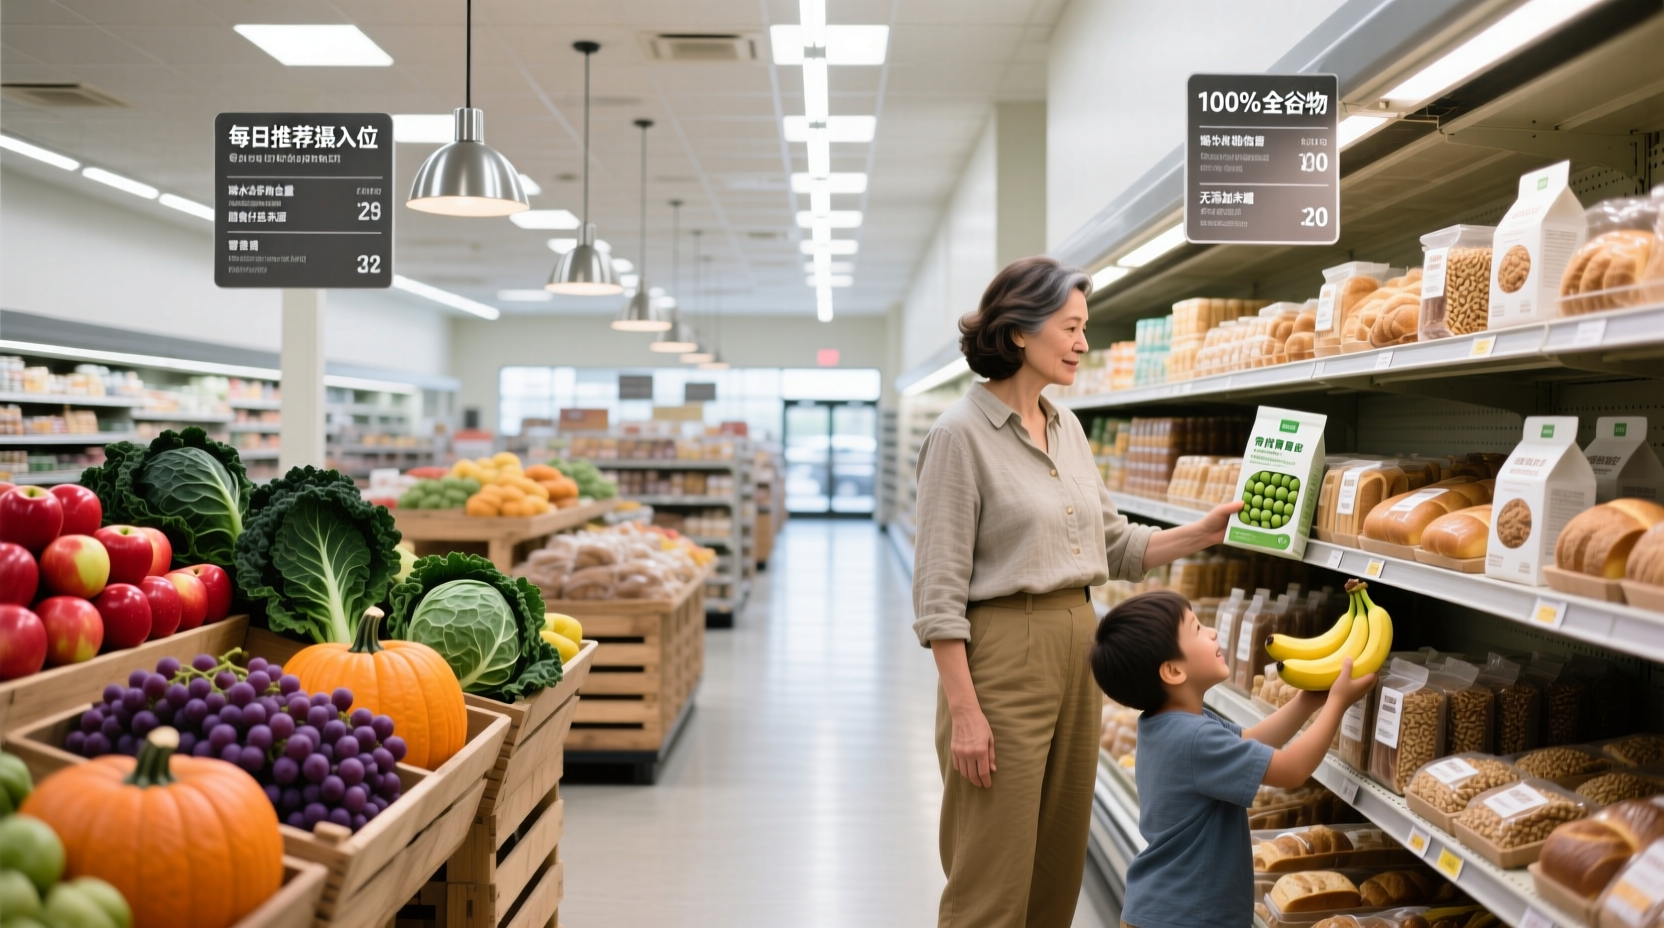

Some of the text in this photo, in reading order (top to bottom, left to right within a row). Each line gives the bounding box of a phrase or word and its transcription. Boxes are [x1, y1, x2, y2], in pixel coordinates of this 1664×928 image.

[1198, 90, 1328, 115] 100%全谷物
[356, 254, 382, 274] 32
